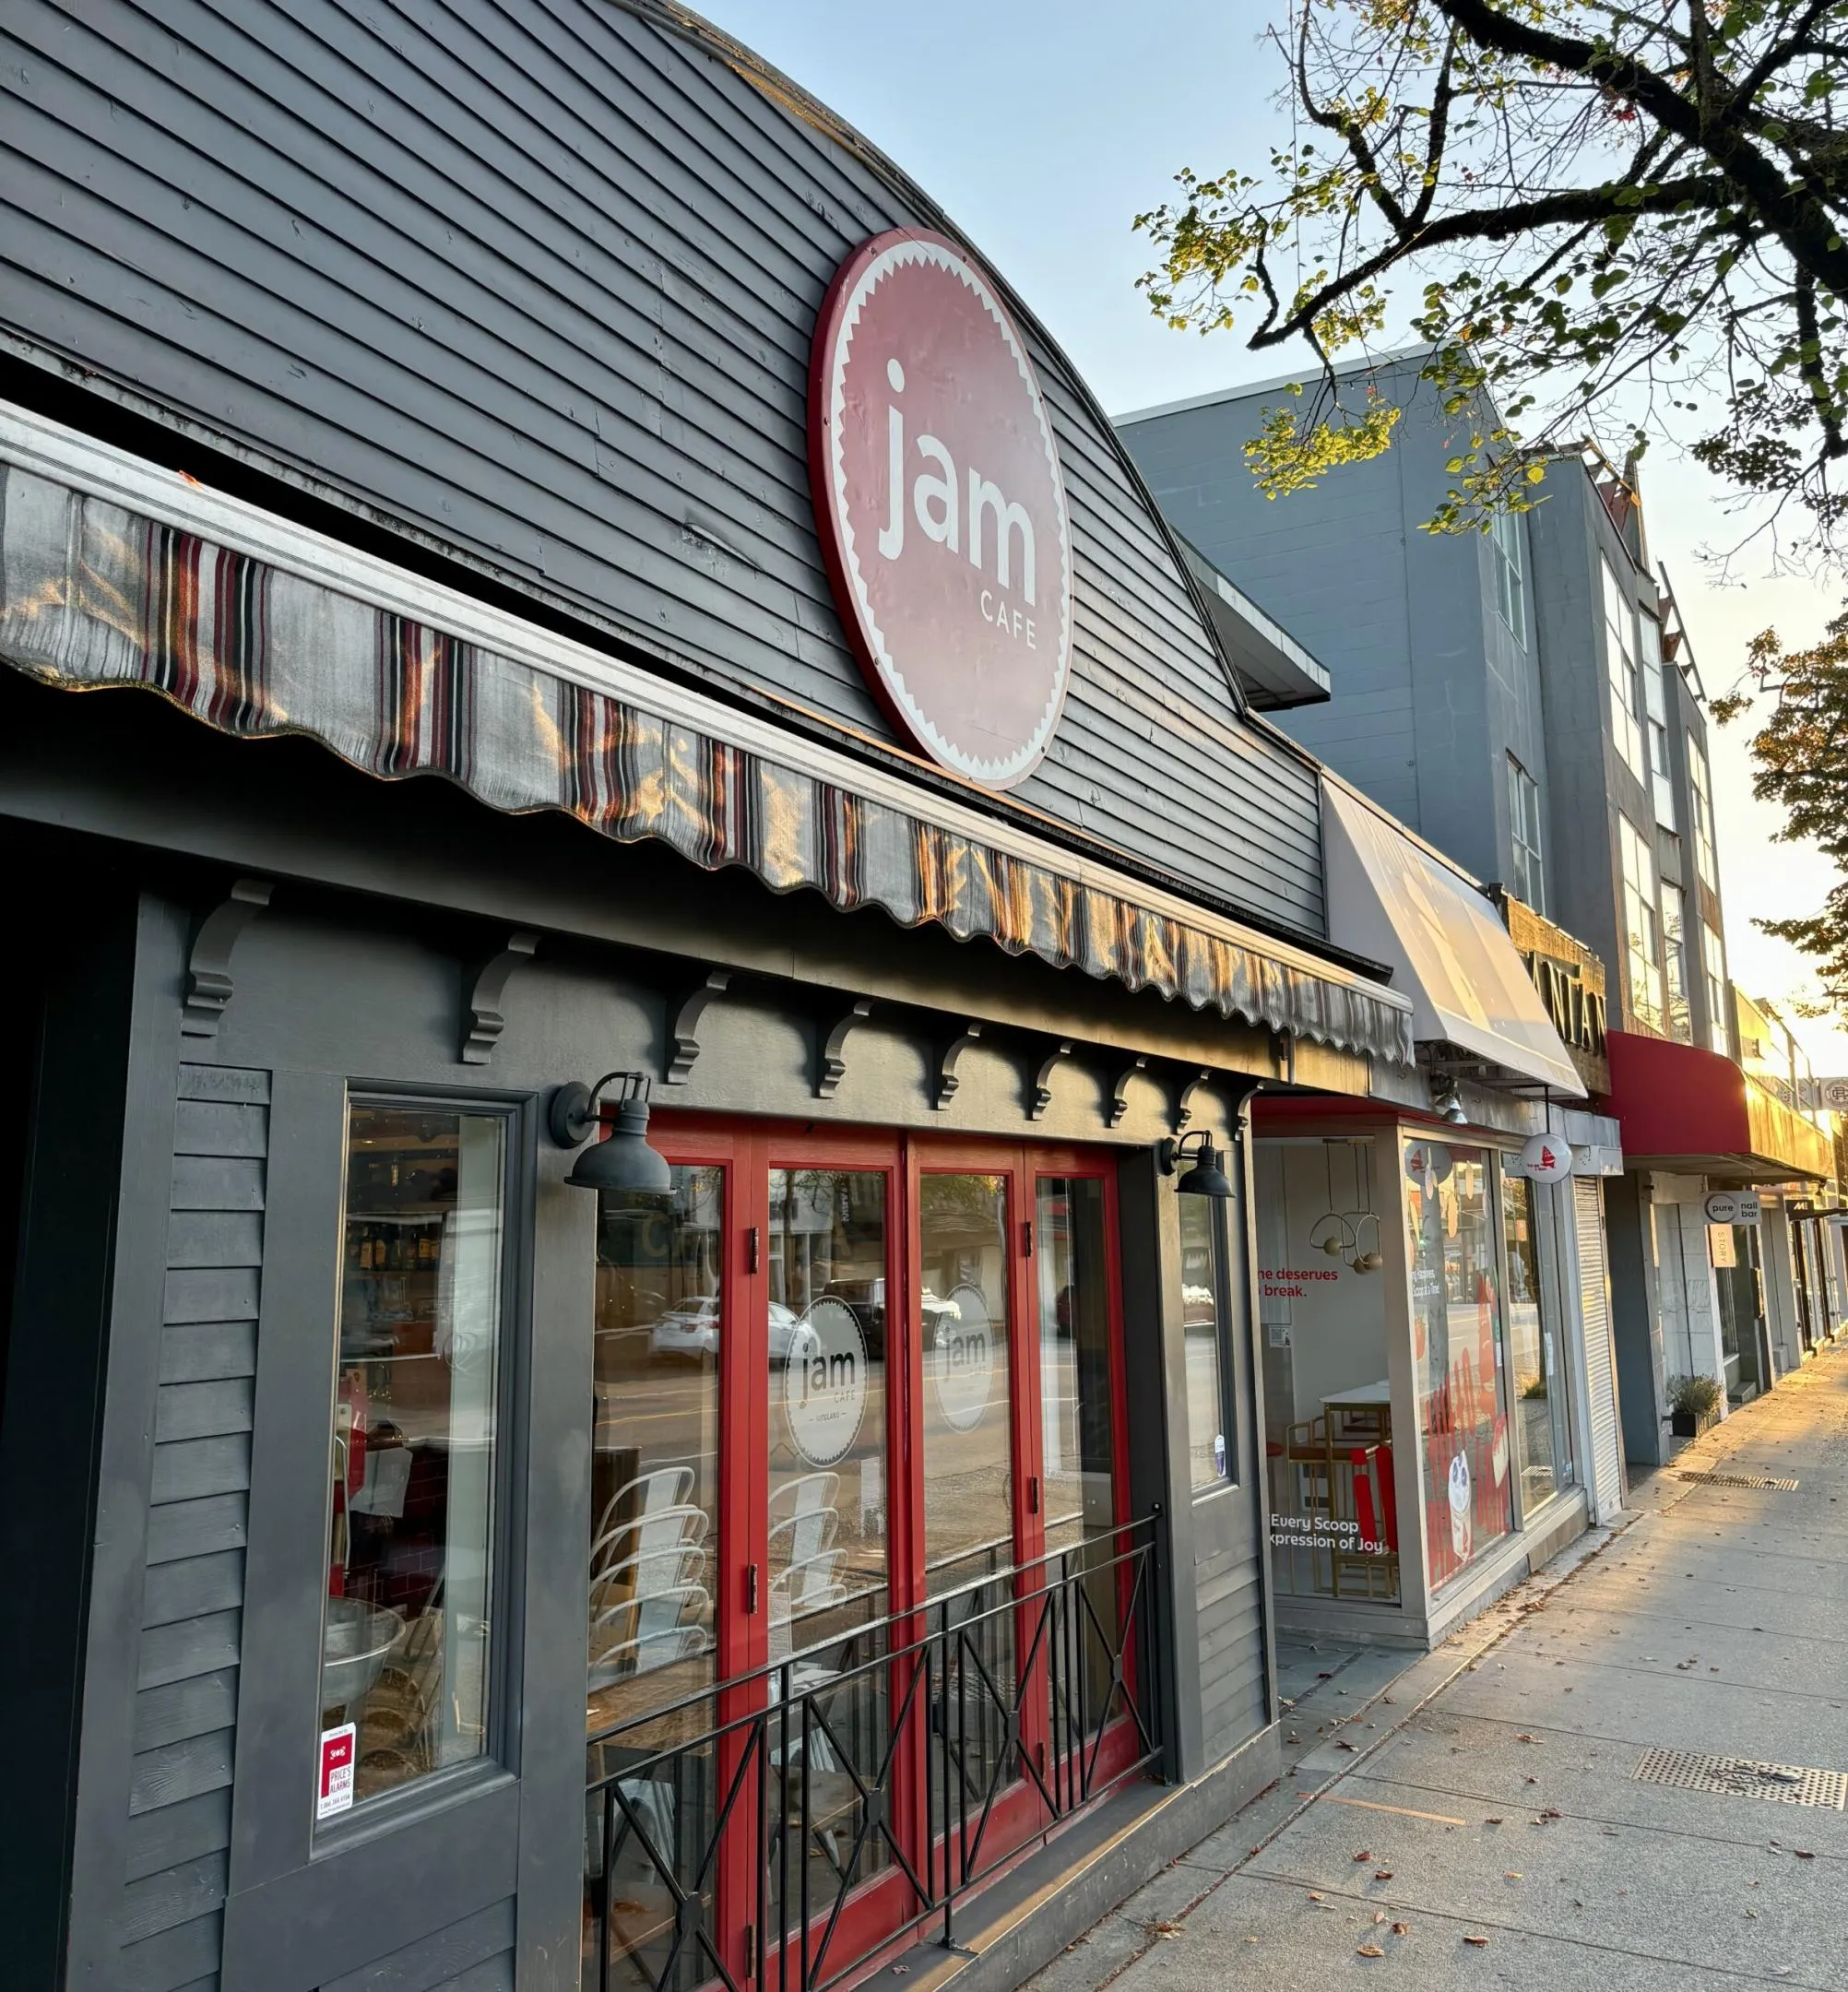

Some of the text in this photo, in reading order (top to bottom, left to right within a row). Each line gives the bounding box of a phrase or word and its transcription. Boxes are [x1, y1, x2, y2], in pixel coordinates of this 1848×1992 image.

[879, 358, 1036, 608] jam
[980, 589, 1036, 649] CAFE
[1712, 1204, 1734, 1214] pure
[1740, 1202, 1758, 1210] nail
[1718, 1231, 1727, 1263] STORY
[1275, 1267, 1338, 1281] deserves
[1264, 1284, 1307, 1298] break.
[944, 1325, 986, 1382] jam
[799, 1342, 855, 1409] jam
[834, 1389, 856, 1404] CAFE
[1314, 1516, 1358, 1535] Scoop
[1339, 1537, 1355, 1549] of
[1357, 1537, 1383, 1554] Joy
[331, 1766, 351, 1783] PRICE'S
[329, 1778, 351, 1794] ALARMS
